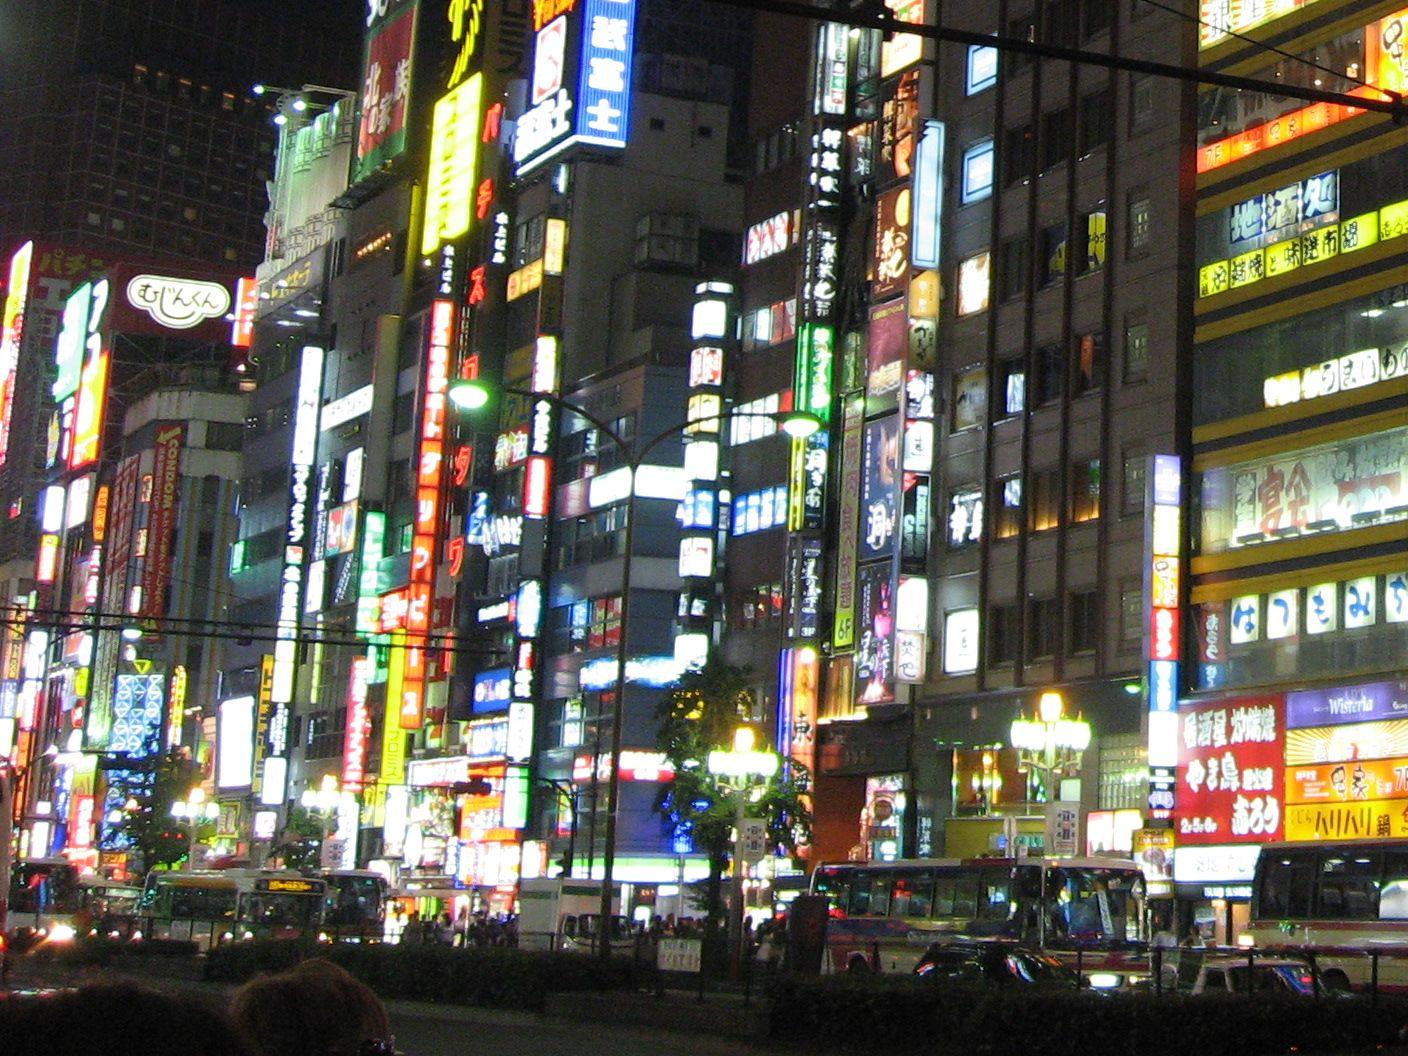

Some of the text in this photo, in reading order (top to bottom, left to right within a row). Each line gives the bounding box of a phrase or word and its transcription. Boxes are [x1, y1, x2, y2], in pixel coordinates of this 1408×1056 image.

[592, 15, 628, 133] 武富士
[137, 282, 219, 320] むじんくん
[1328, 698, 1374, 715] Wisteria
